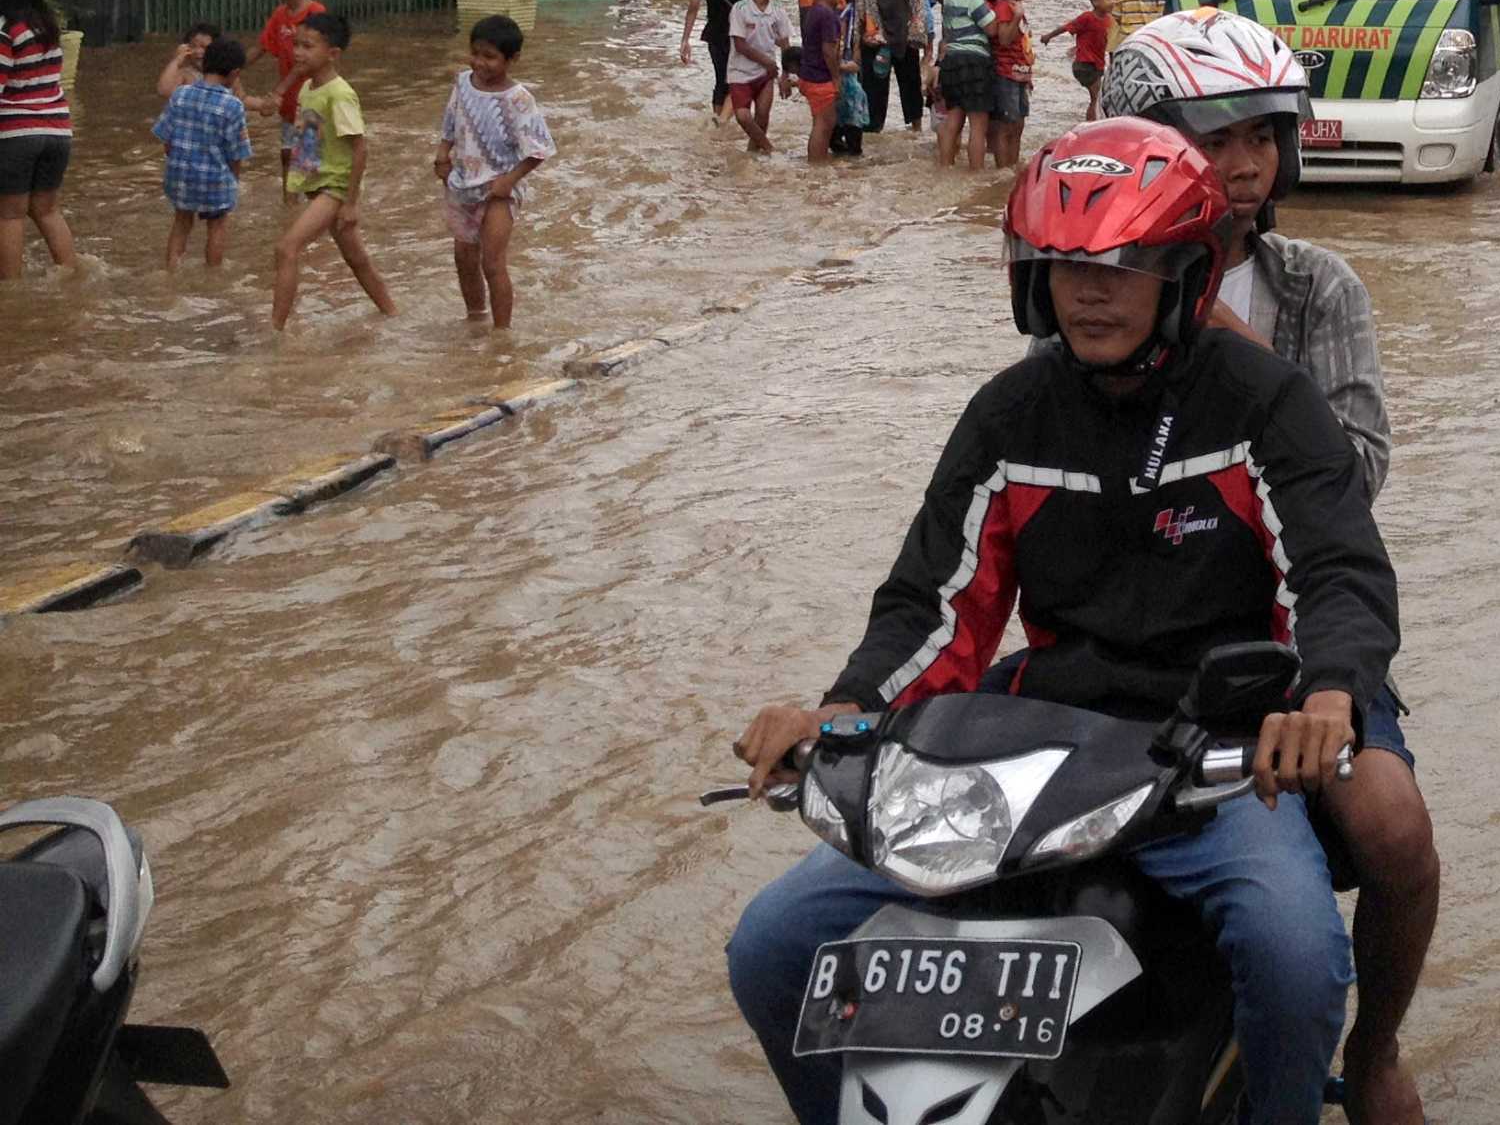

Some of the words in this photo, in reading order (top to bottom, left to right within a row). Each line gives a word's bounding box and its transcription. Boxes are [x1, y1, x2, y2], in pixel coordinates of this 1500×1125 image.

[1301, 26, 1393, 51] DARURAT
[1311, 121, 1338, 137] UHX
[1066, 158, 1119, 172] MDS
[1144, 416, 1174, 480] MULANA
[812, 954, 838, 999] B
[864, 949, 967, 995] 6156
[997, 952, 1068, 999] TII
